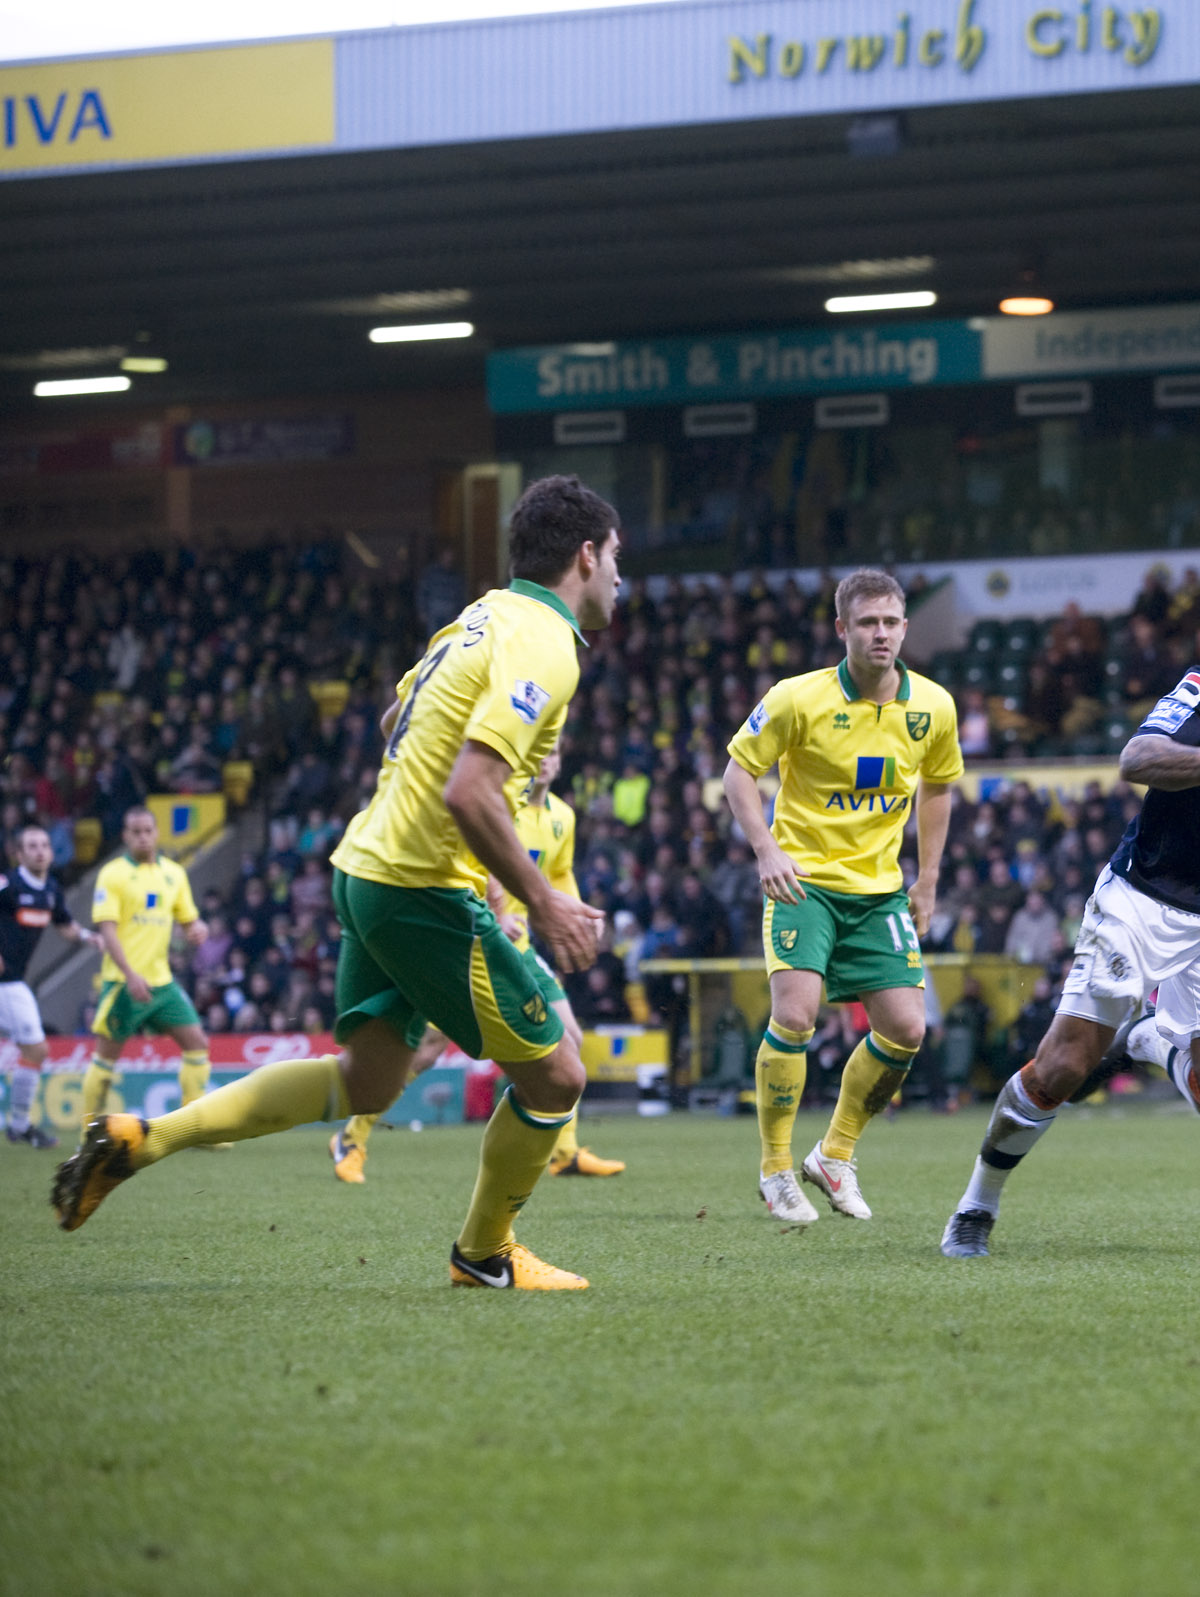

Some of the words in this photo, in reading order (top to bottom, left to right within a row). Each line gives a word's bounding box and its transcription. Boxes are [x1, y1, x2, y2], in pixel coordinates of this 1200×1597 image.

[728, 0, 984, 82] Norwich
[1026, 0, 1160, 66] City
[538, 349, 669, 397] Smith
[685, 345, 719, 386] &
[738, 331, 937, 384] Pinching
[826, 791, 909, 813] AVIVA
[885, 912, 919, 952] 15
